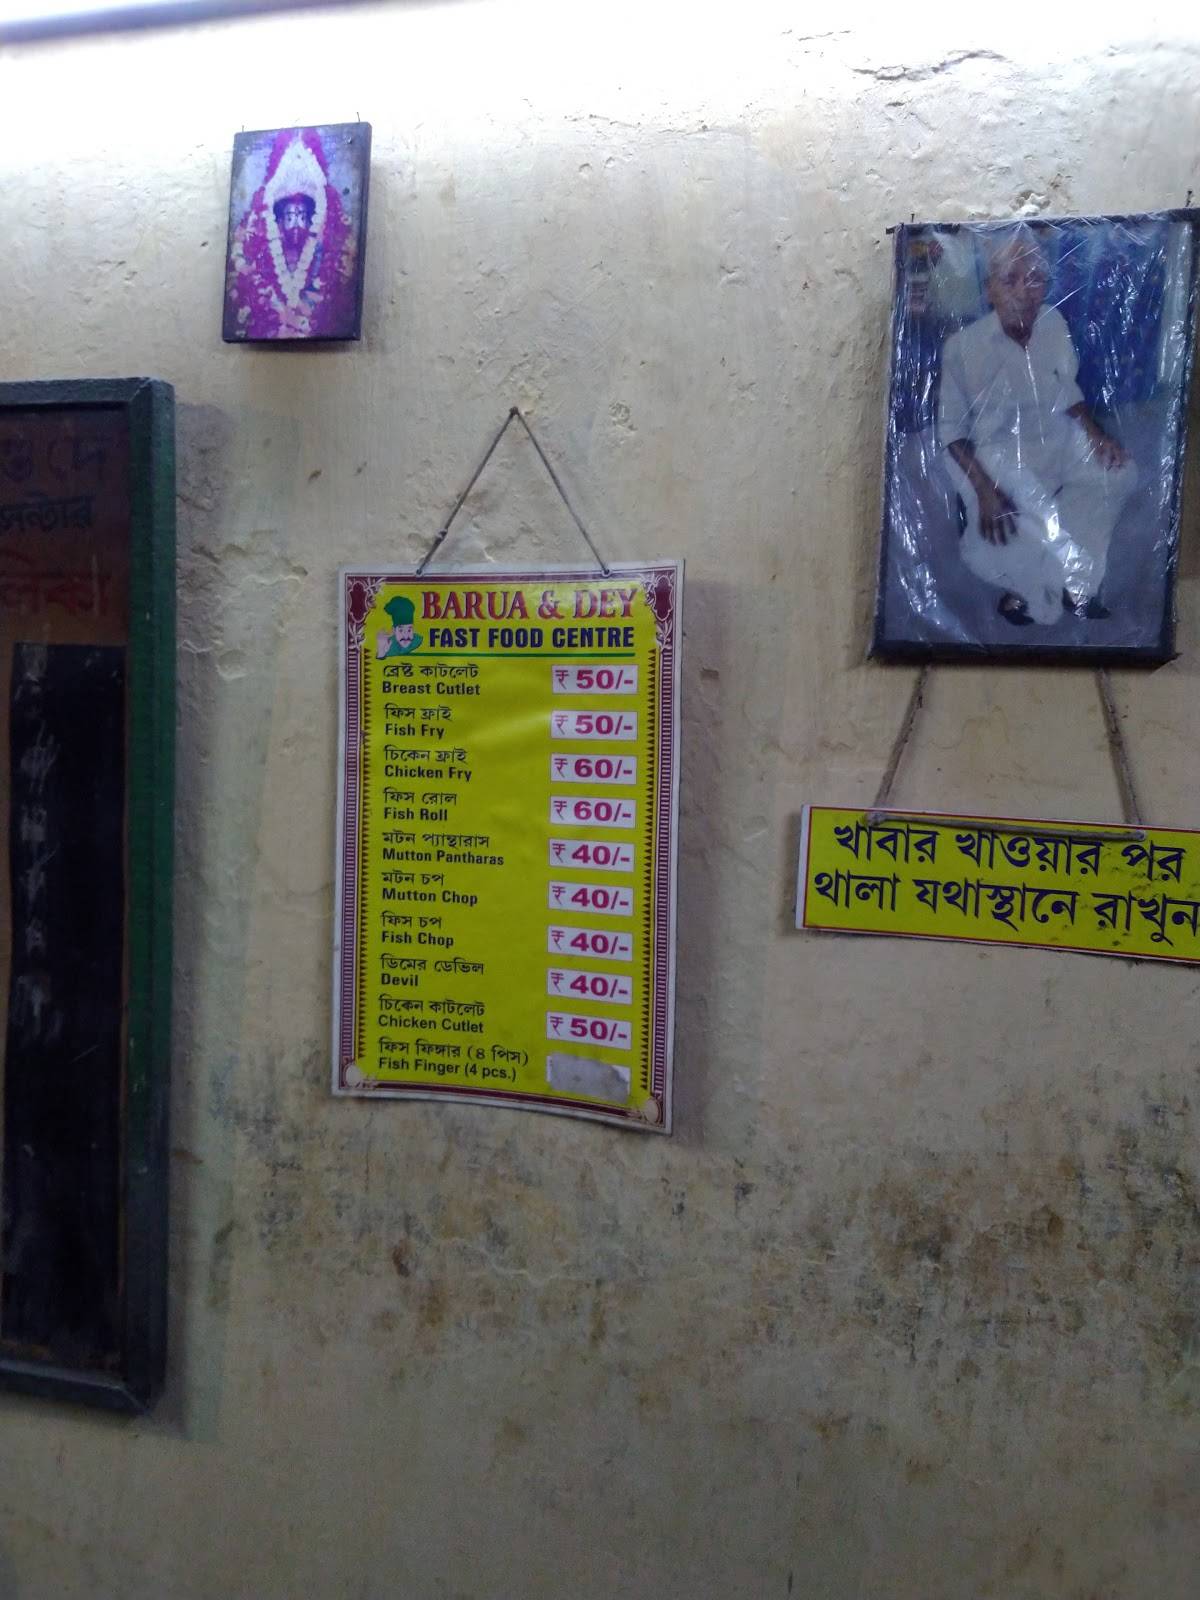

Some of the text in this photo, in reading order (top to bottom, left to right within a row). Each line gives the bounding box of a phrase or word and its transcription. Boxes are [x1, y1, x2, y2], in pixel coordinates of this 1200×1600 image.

[422, 590, 637, 620] BARUA & DEY
[429, 627, 635, 648] FAST FOOD CENTRE
[419, 663, 479, 678] কাটলেট
[383, 682, 480, 695] Breast Cutlet
[384, 703, 452, 721] ফিস ফ্রাই
[385, 724, 444, 739] Fish Fry
[384, 745, 467, 764] চিকেন ফ্রাই
[385, 765, 471, 782] Chicken Fry
[383, 787, 457, 805] ফিস রোল
[384, 807, 447, 821] Fish Roll
[382, 829, 415, 844] মটন
[383, 848, 504, 865] Mutton Pantharas
[833, 821, 1186, 882] খাবার খাওয়ার পর
[382, 869, 444, 886] মটন চপ
[382, 888, 478, 906] Mutton Chop
[814, 869, 900, 912] থালা
[914, 877, 1080, 932] যথাস্থানে
[381, 911, 442, 928] ফিস চপ
[382, 931, 453, 948] Fish Chop
[379, 953, 484, 974] ডিমের ডেভিল
[381, 974, 418, 986] Devil
[379, 993, 485, 1016] চিকেন কাটলেট
[378, 1015, 483, 1033] Chicken Cutlet
[379, 1037, 409, 1054] ফিস
[379, 1058, 516, 1081] Fish Finger (4 pcs.)
